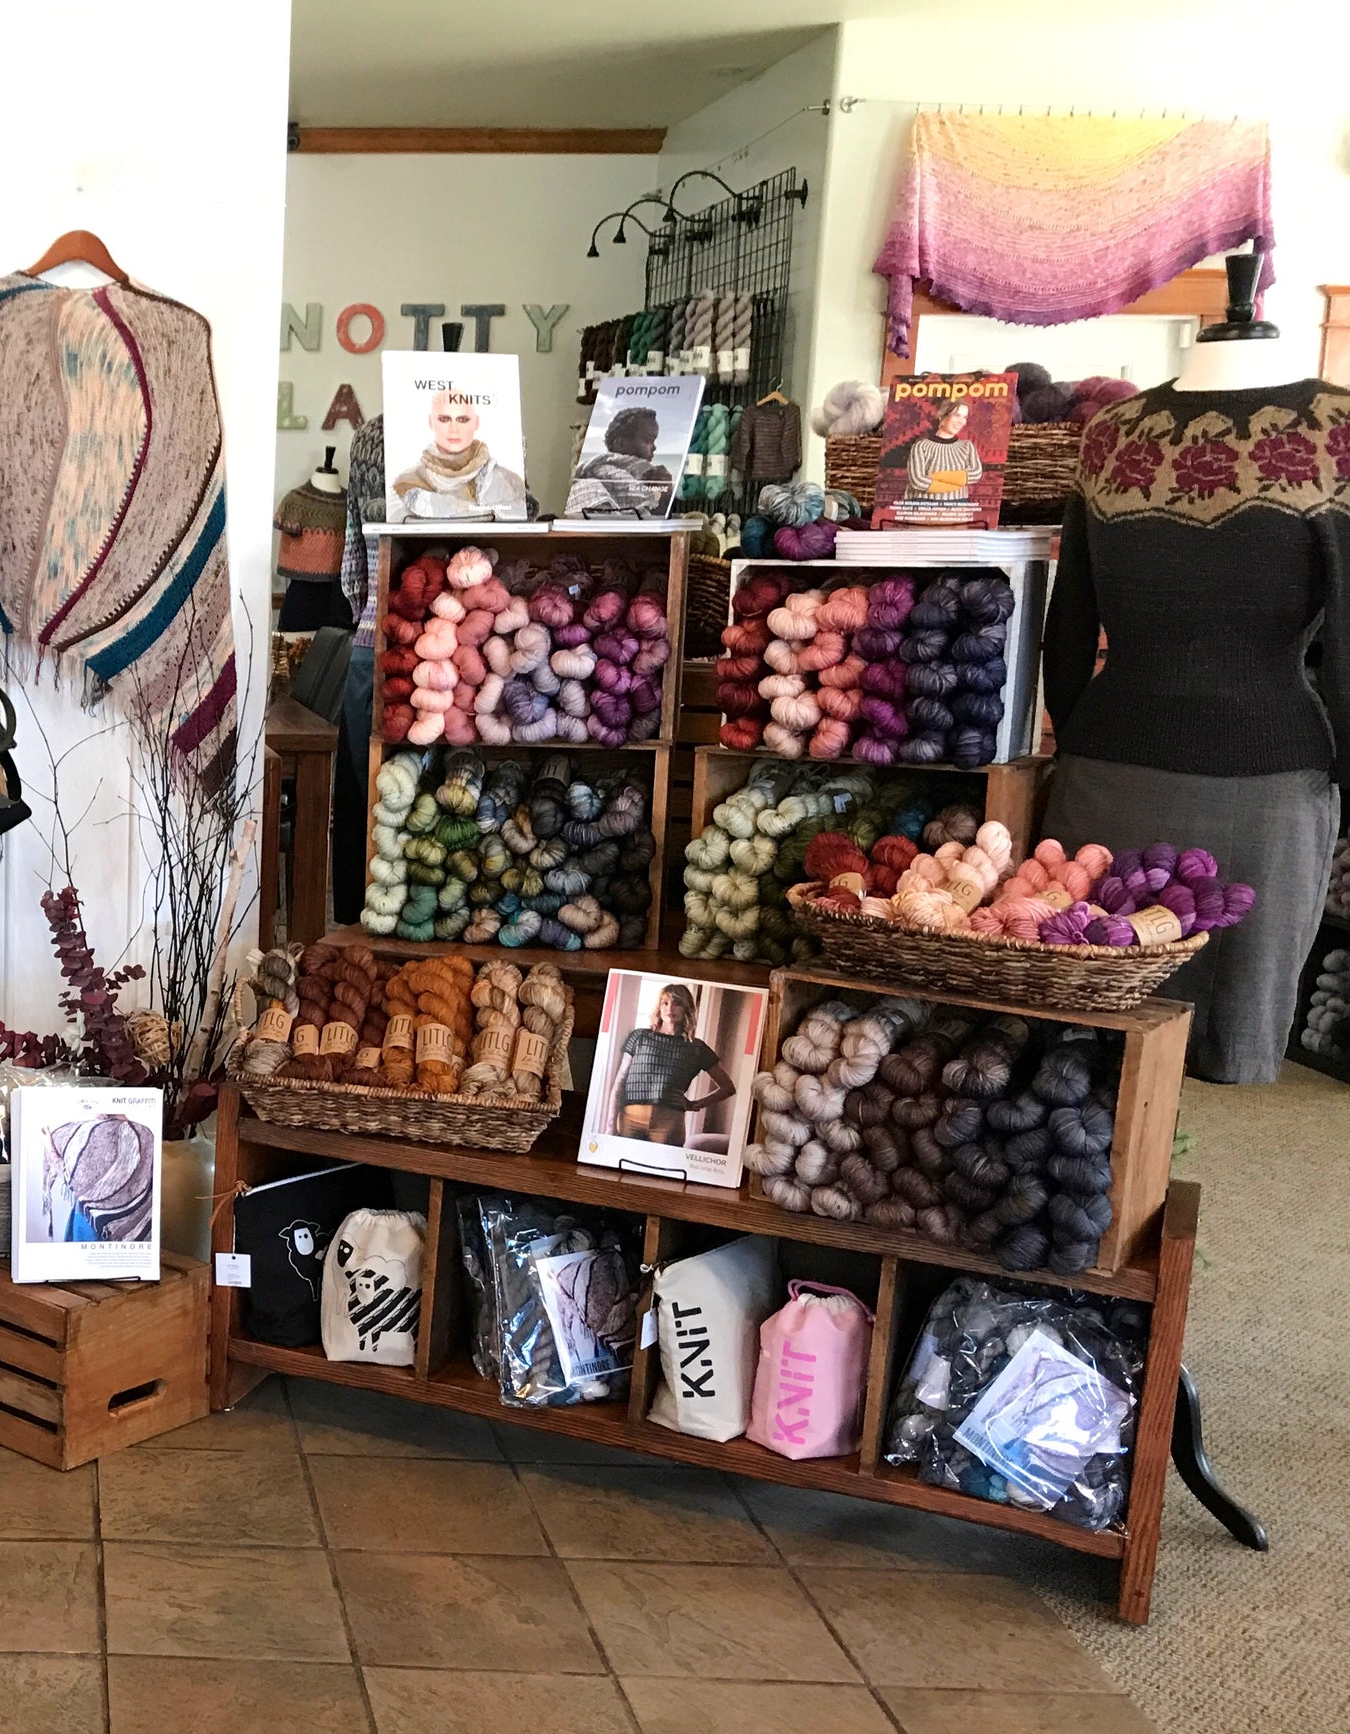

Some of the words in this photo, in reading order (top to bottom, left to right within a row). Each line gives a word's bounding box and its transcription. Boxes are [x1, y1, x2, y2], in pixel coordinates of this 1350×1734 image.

[414, 379, 454, 391] WEST
[615, 385, 681, 398] pompom
[895, 382, 1008, 402] pompom
[449, 393, 491, 406] KNITS
[128, 1097, 156, 1105] GRAFFITI
[685, 1153, 727, 1167] VELLICHOR
[672, 1301, 716, 1398] KNIT
[772, 1340, 816, 1445] KNIT
